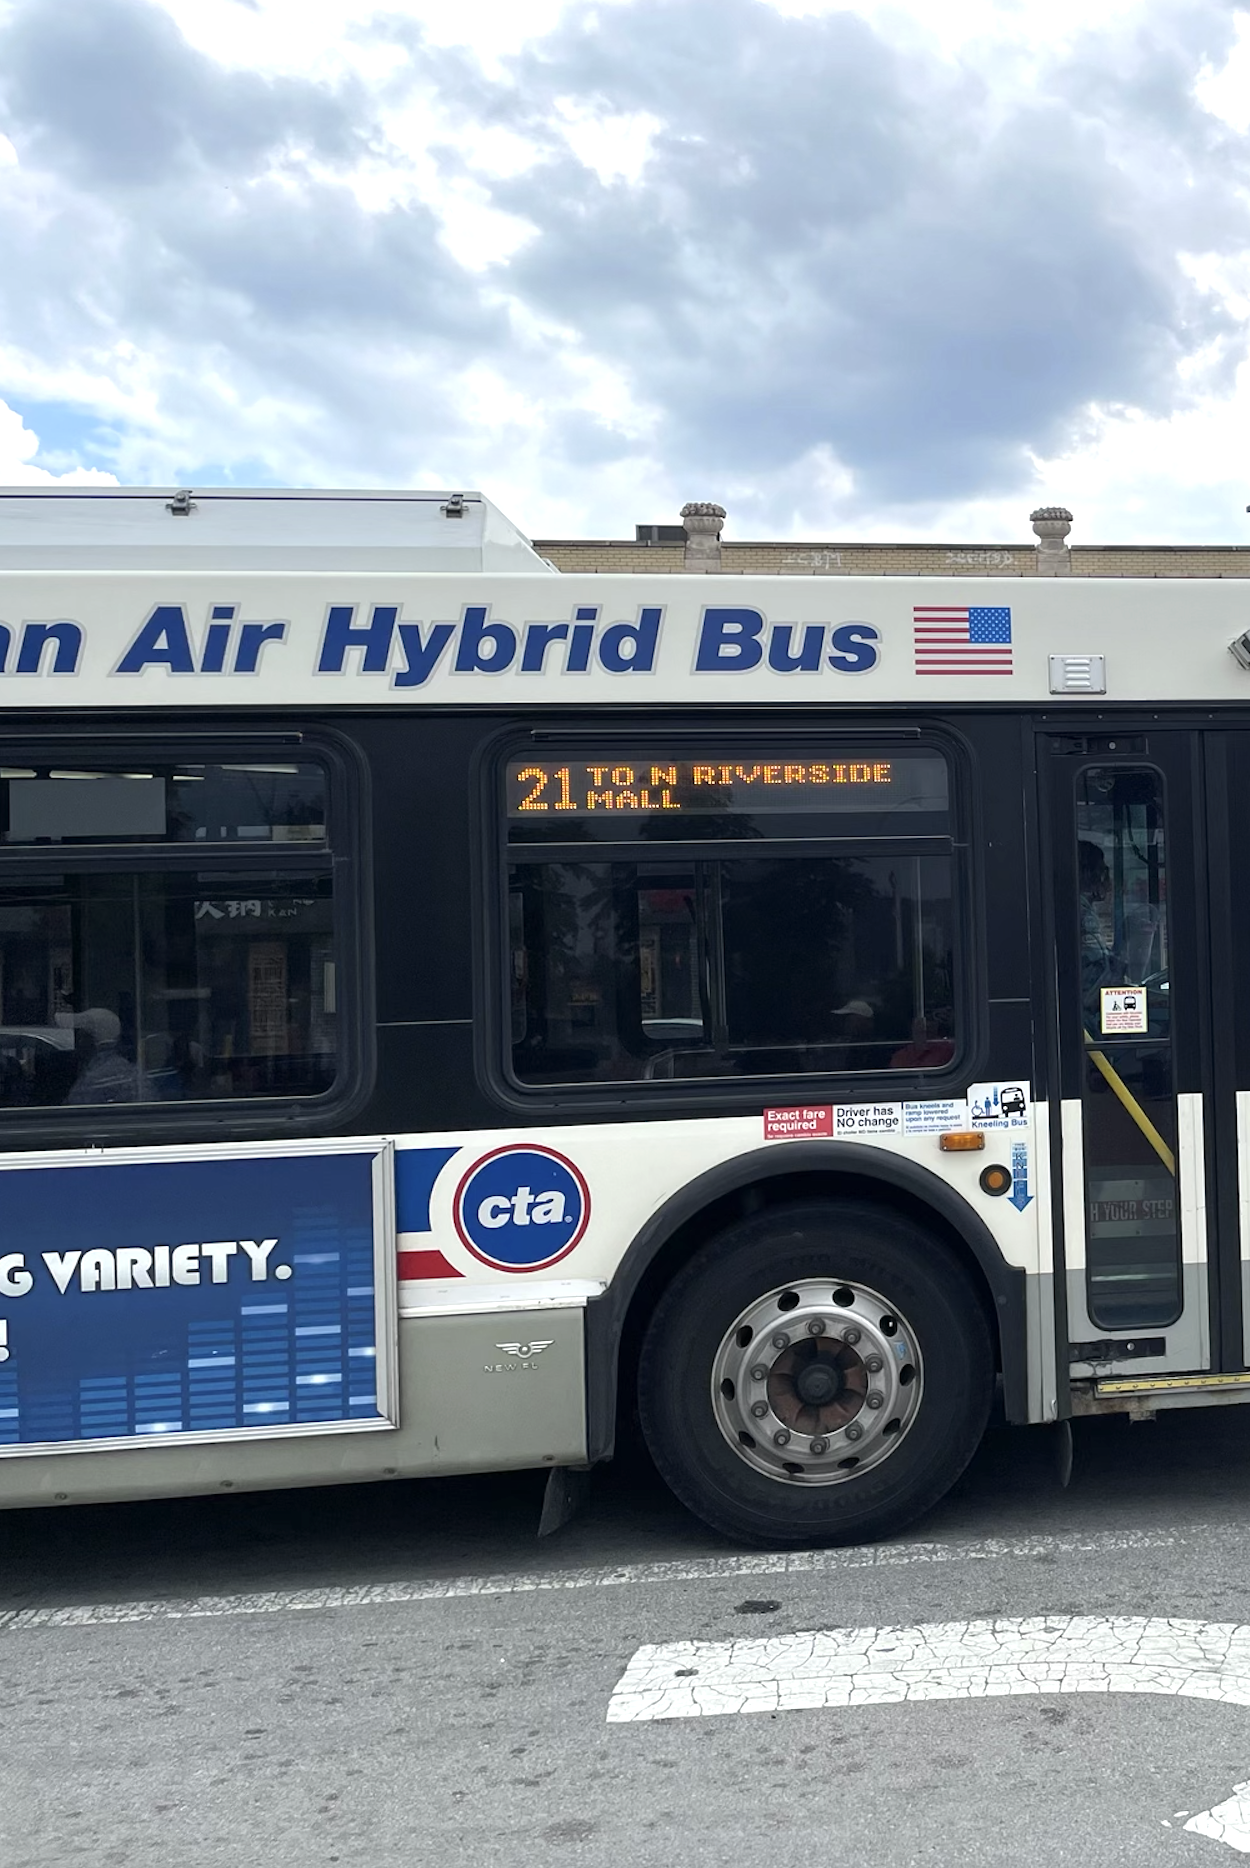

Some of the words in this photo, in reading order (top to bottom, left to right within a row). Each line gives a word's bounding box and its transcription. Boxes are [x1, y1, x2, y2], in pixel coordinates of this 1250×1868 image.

[0, 621, 83, 675] n
[112, 604, 288, 675] Air
[315, 604, 664, 688] Hybrid
[693, 606, 880, 674] Bus
[516, 766, 578, 811] 21
[586, 766, 634, 786] TO
[650, 766, 677, 786] N
[693, 764, 892, 785] RIVERSIDE
[586, 789, 682, 810] MALL
[767, 1110, 800, 1120] Exact
[803, 1109, 826, 1119] fare
[837, 1108, 870, 1118] Driver
[873, 1106, 894, 1116] has
[767, 1119, 817, 1132] required
[837, 1118, 855, 1128] NO
[858, 1117, 899, 1128] change
[971, 1119, 1009, 1129] Kneeling
[1011, 1119, 1028, 1127] Bus
[478, 1186, 566, 1229] cta
[1104, 1201, 1137, 1221] YOUR
[1141, 1200, 1172, 1219] STEP
[41, 1238, 293, 1295] VARIETY.
[484, 1363, 517, 1373] NEW
